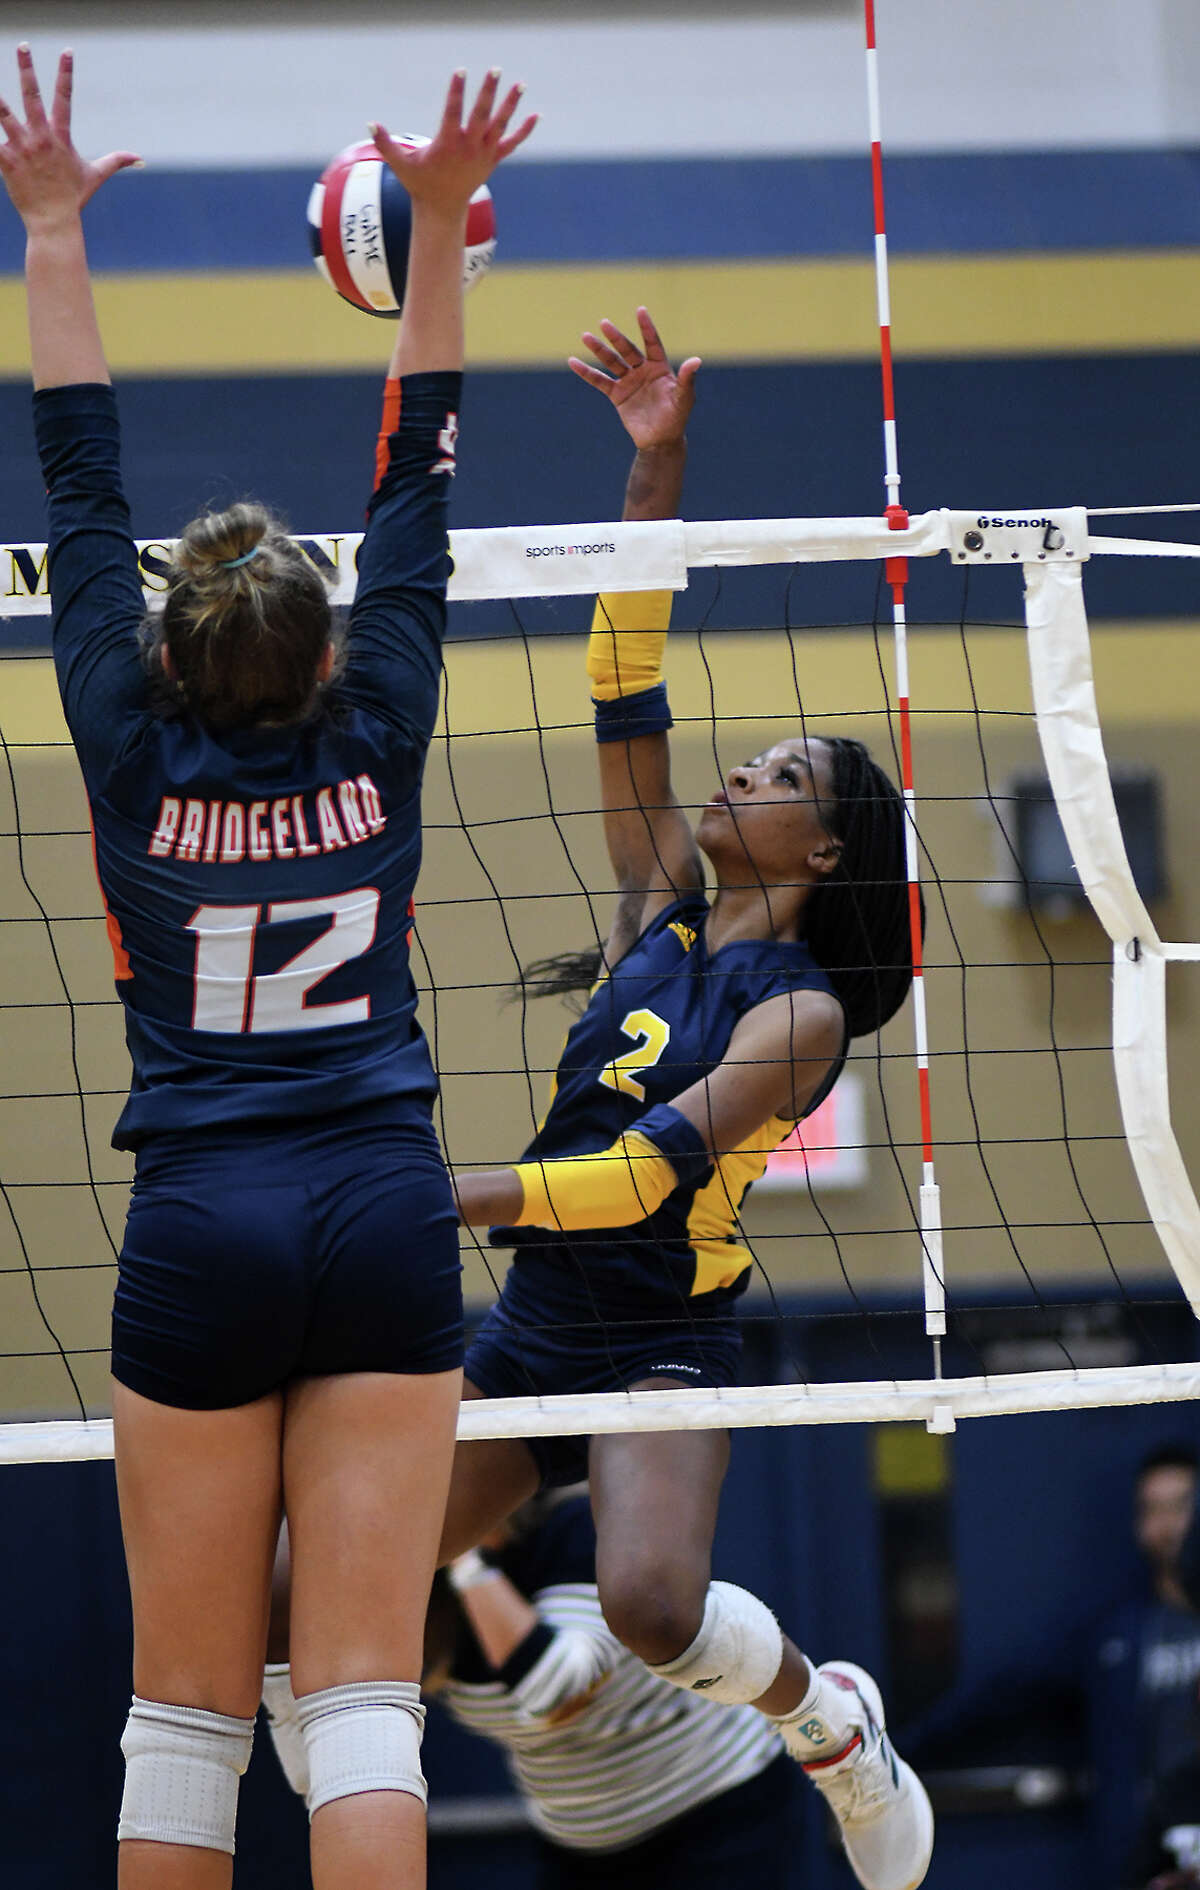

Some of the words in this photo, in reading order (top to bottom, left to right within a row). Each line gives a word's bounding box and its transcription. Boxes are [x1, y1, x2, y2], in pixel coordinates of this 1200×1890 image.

[359, 203, 383, 267] GAME
[526, 546, 566, 558] sports
[991, 517, 1052, 528] Senoh
[148, 773, 388, 863] BRIDGELAND
[184, 886, 382, 1034] 12
[598, 1008, 671, 1103] 2
